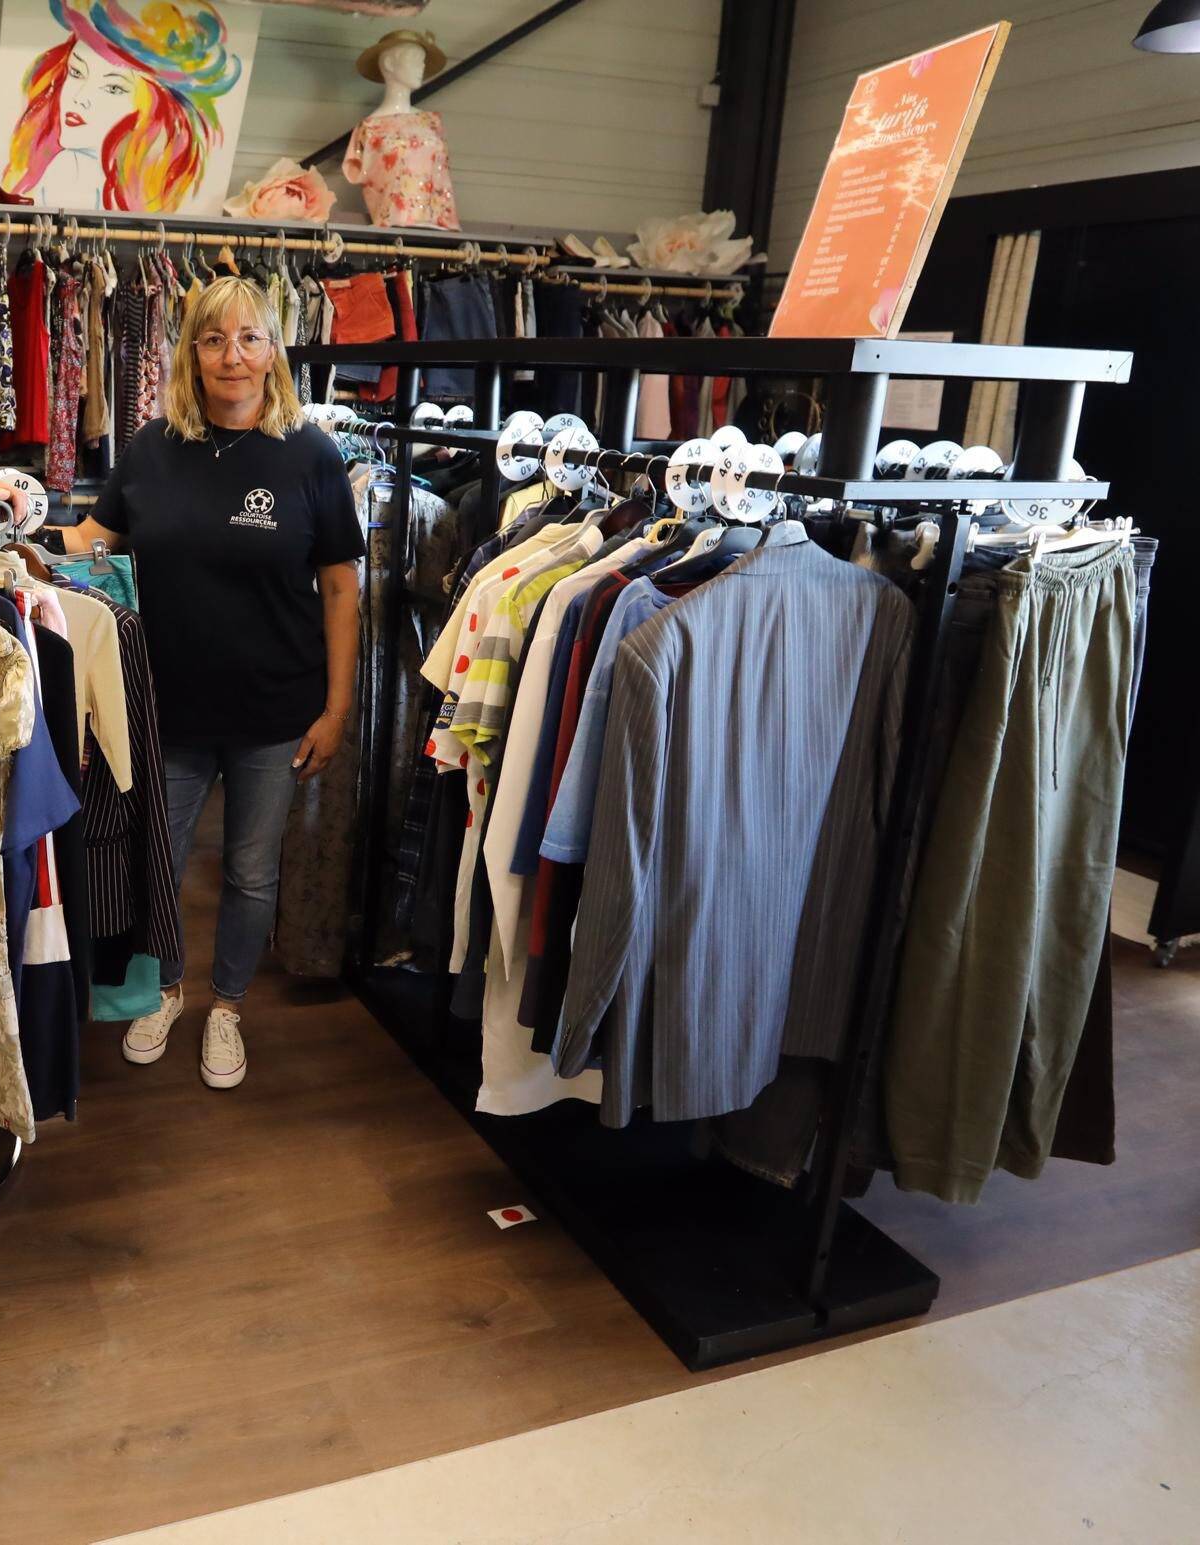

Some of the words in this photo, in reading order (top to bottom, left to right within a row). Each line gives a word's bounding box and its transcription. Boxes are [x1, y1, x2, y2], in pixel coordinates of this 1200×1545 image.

[560, 417, 573, 427] 36
[552, 440, 565, 457] 42
[577, 435, 591, 449] 42
[687, 446, 701, 458] 44
[719, 458, 732, 478] 46
[733, 462, 747, 482] 48
[14, 479, 28, 490] 40
[672, 473, 680, 491] 44
[34, 501, 43, 516] 40
[240, 511, 272, 520] COURTOISE
[1027, 504, 1048, 520] 36
[230, 516, 278, 527] RESSOURCERIE
